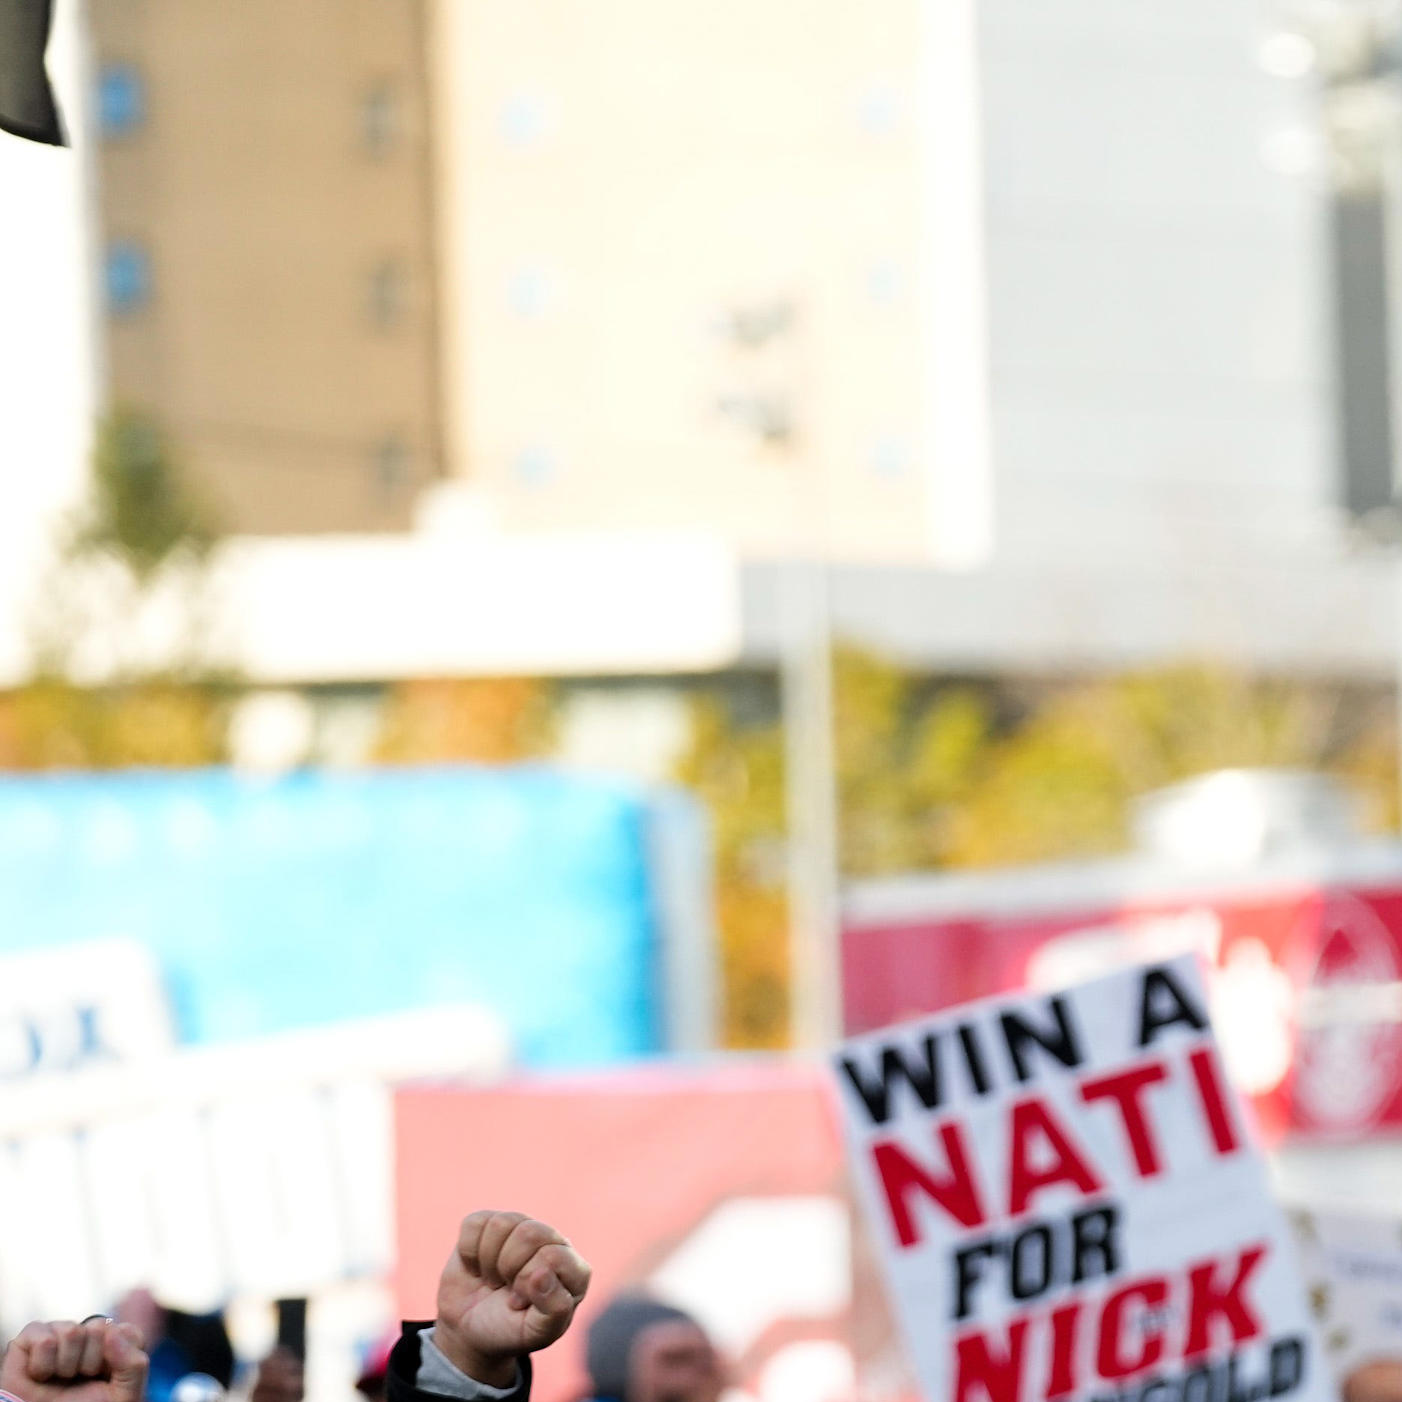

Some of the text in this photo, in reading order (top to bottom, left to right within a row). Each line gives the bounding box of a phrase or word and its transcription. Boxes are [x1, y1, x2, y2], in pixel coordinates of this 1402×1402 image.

[842, 967, 1208, 1124] WIN A
[871, 1047, 1240, 1249] NATI
[953, 1206, 1121, 1318] FOR
